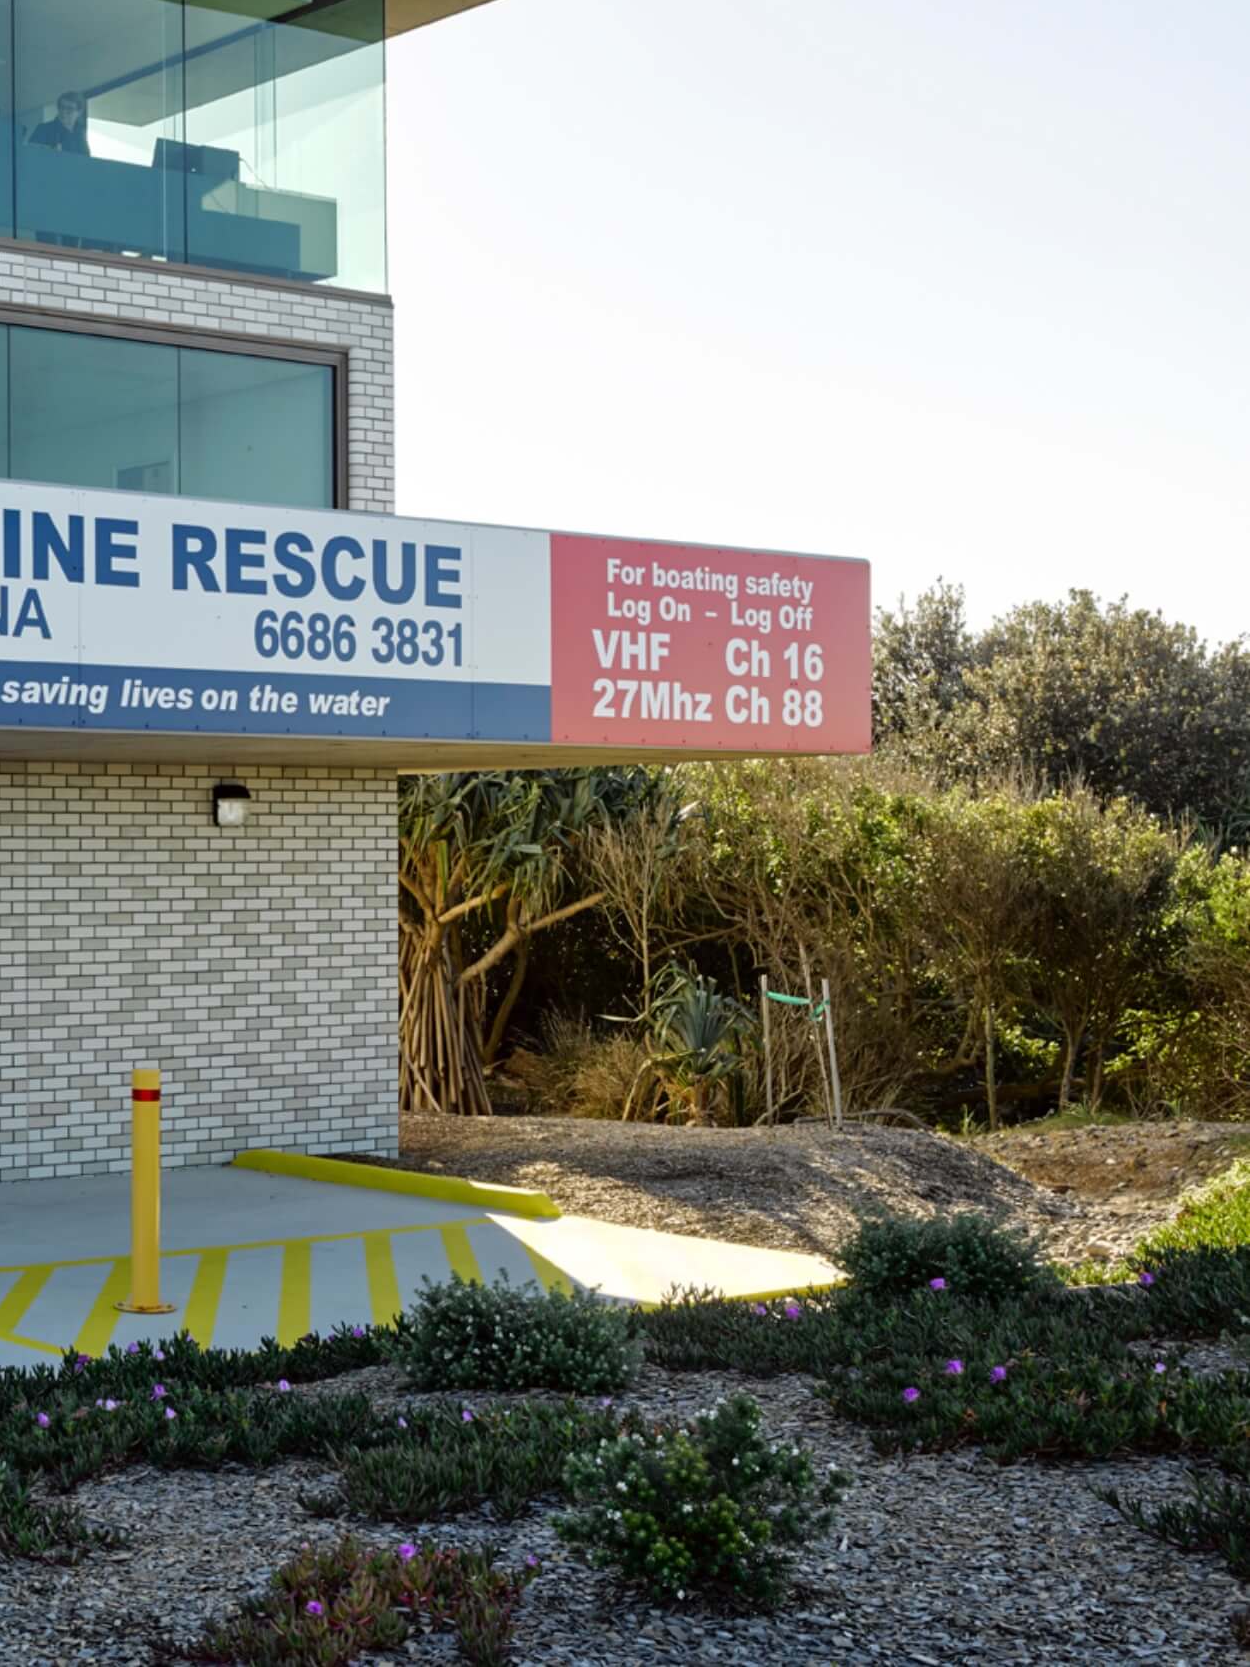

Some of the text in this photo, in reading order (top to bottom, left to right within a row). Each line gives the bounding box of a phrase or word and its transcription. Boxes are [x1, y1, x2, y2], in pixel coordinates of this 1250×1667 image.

[172, 523, 463, 609] RESCUE
[607, 558, 813, 605] For boating safety
[607, 591, 651, 625] Log
[659, 595, 691, 622] On
[731, 601, 772, 633] Log
[779, 605, 813, 631] Off
[254, 609, 463, 667] 6686 3831
[592, 629, 824, 682] VHF Ch 16
[0, 674, 109, 714] saving
[120, 679, 193, 710] lives
[200, 688, 238, 711] on
[249, 684, 298, 713] the
[309, 690, 391, 717] water
[592, 678, 824, 727] 27Mhz Ch 88
